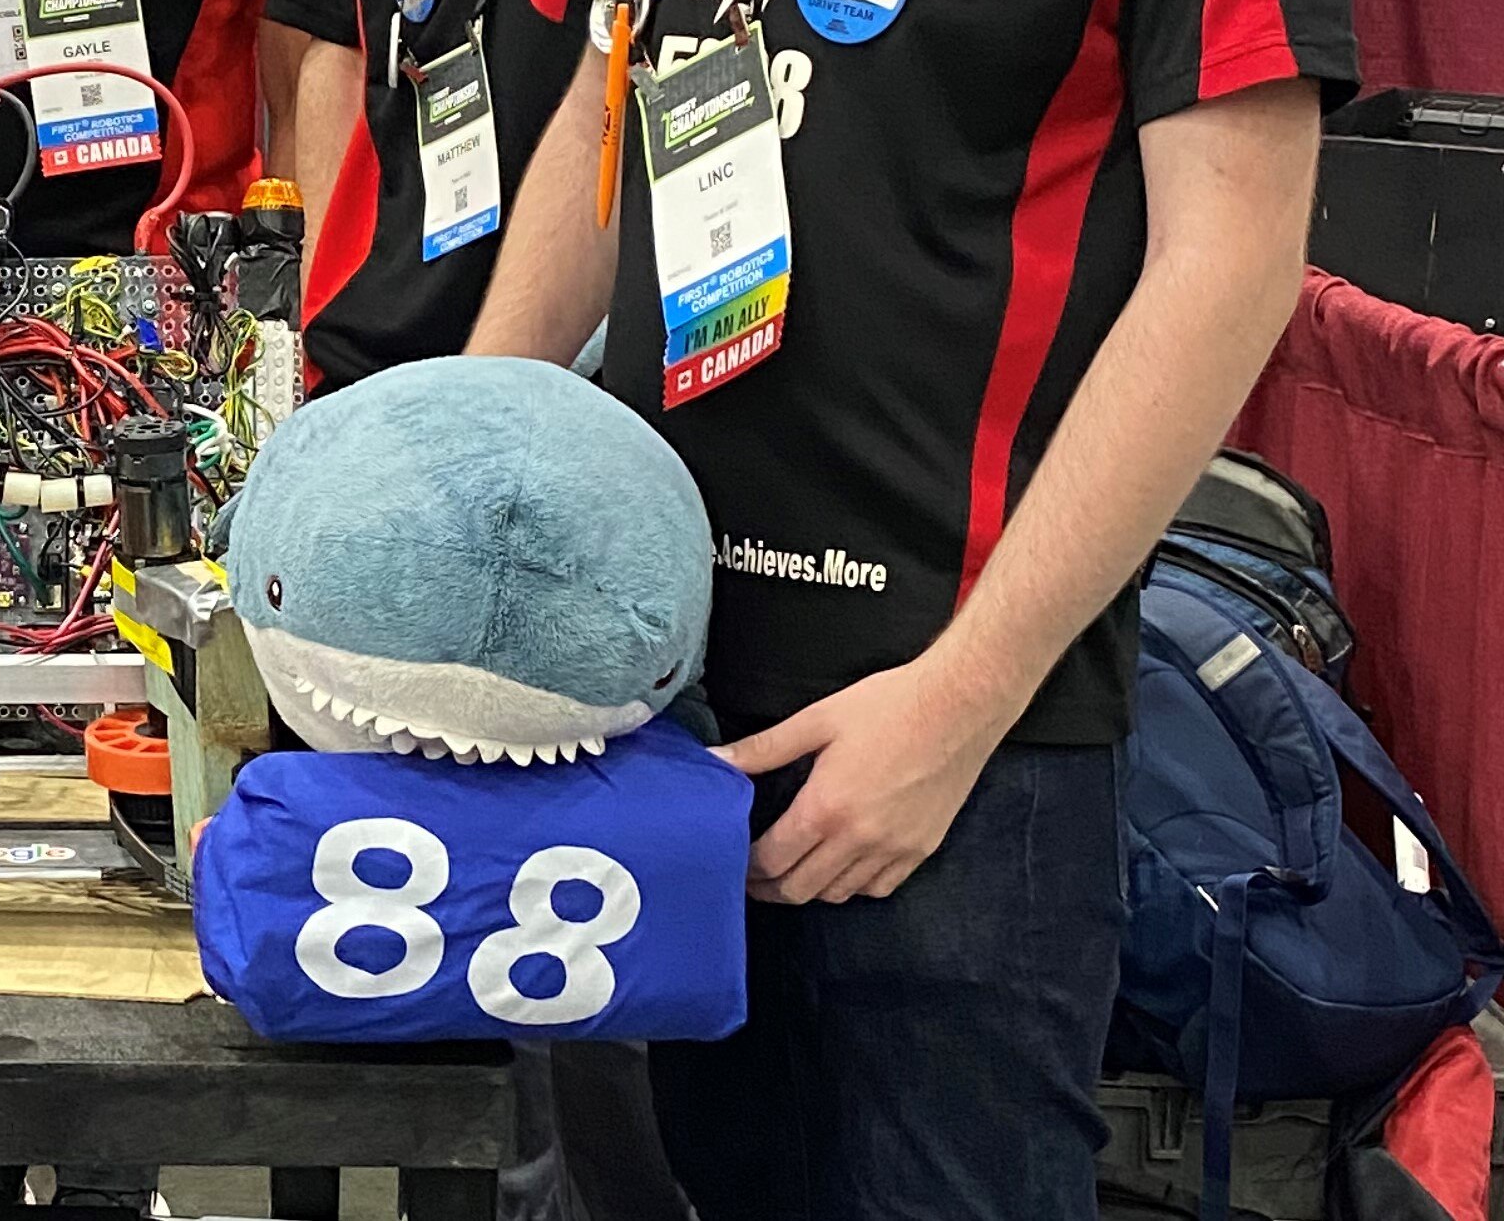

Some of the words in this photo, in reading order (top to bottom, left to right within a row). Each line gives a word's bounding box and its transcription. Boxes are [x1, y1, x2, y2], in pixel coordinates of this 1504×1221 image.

[842, 1, 875, 21] TEAM
[62, 40, 113, 59] GAYLE
[64, 125, 133, 142] COMPETITION
[91, 113, 144, 129] ROBOTICS
[76, 134, 153, 165] CANADA
[436, 133, 482, 167] MATTHEW
[698, 161, 735, 193] LINC
[718, 248, 775, 286] ROBOTICS
[690, 268, 764, 314] COMPETITION
[683, 325, 709, 356] I'M
[711, 312, 735, 343] AN
[738, 294, 772, 330] ALLY
[700, 322, 776, 384] CANADA
[295, 817, 641, 1026] 88
